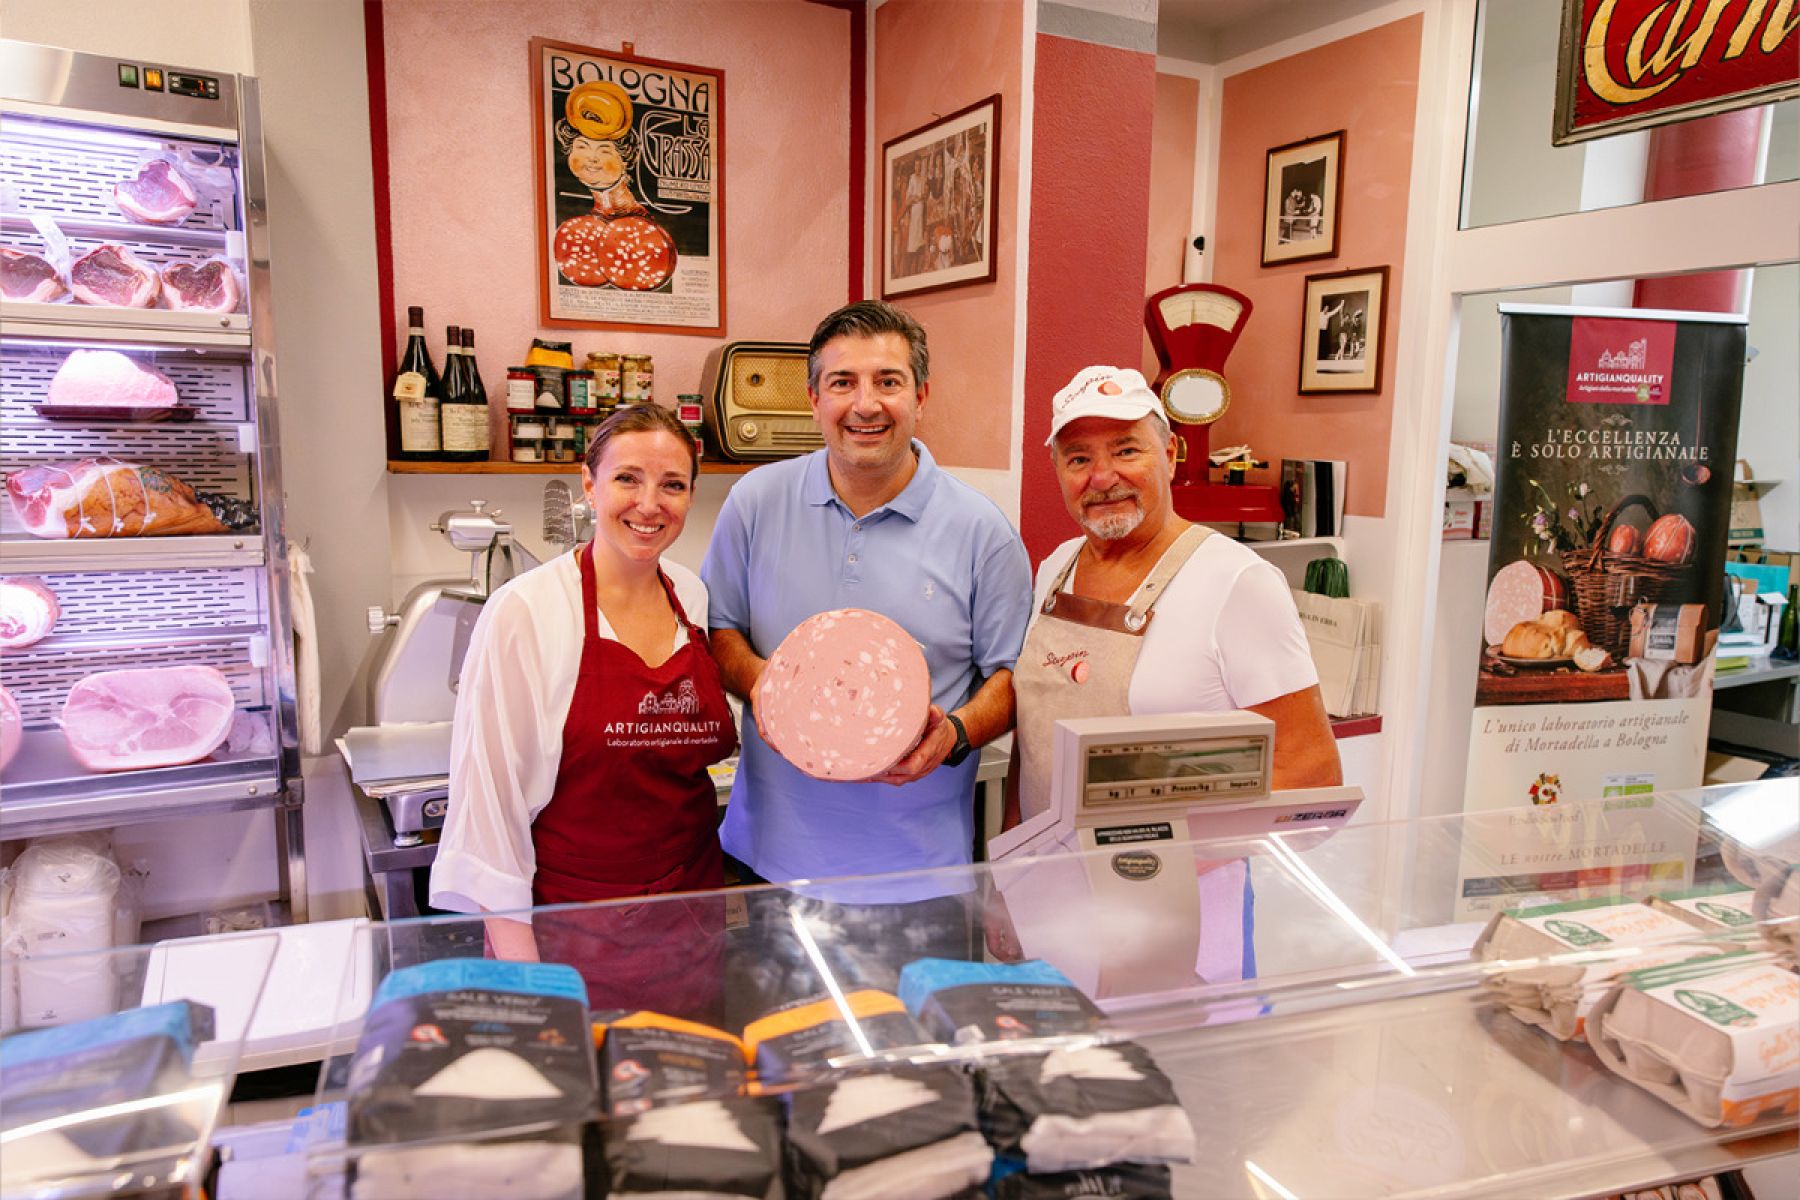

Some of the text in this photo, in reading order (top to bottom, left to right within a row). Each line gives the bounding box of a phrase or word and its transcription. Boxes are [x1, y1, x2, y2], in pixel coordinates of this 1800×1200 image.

[552, 56, 709, 113] BOLOGNA
[1576, 372, 1664, 384] ARTIGIANQUALITY
[1547, 429, 1681, 445] L'ECCELLENZA
[1511, 441, 1710, 460] È SOLO ARTIGIANALE
[604, 721, 721, 734] ARTIGIANQUALITY
[1483, 710, 1690, 734] L'unico laboratorio artigianale
[1504, 732, 1668, 754] di Mortadella a Bologna
[1500, 853, 1519, 866] LE
